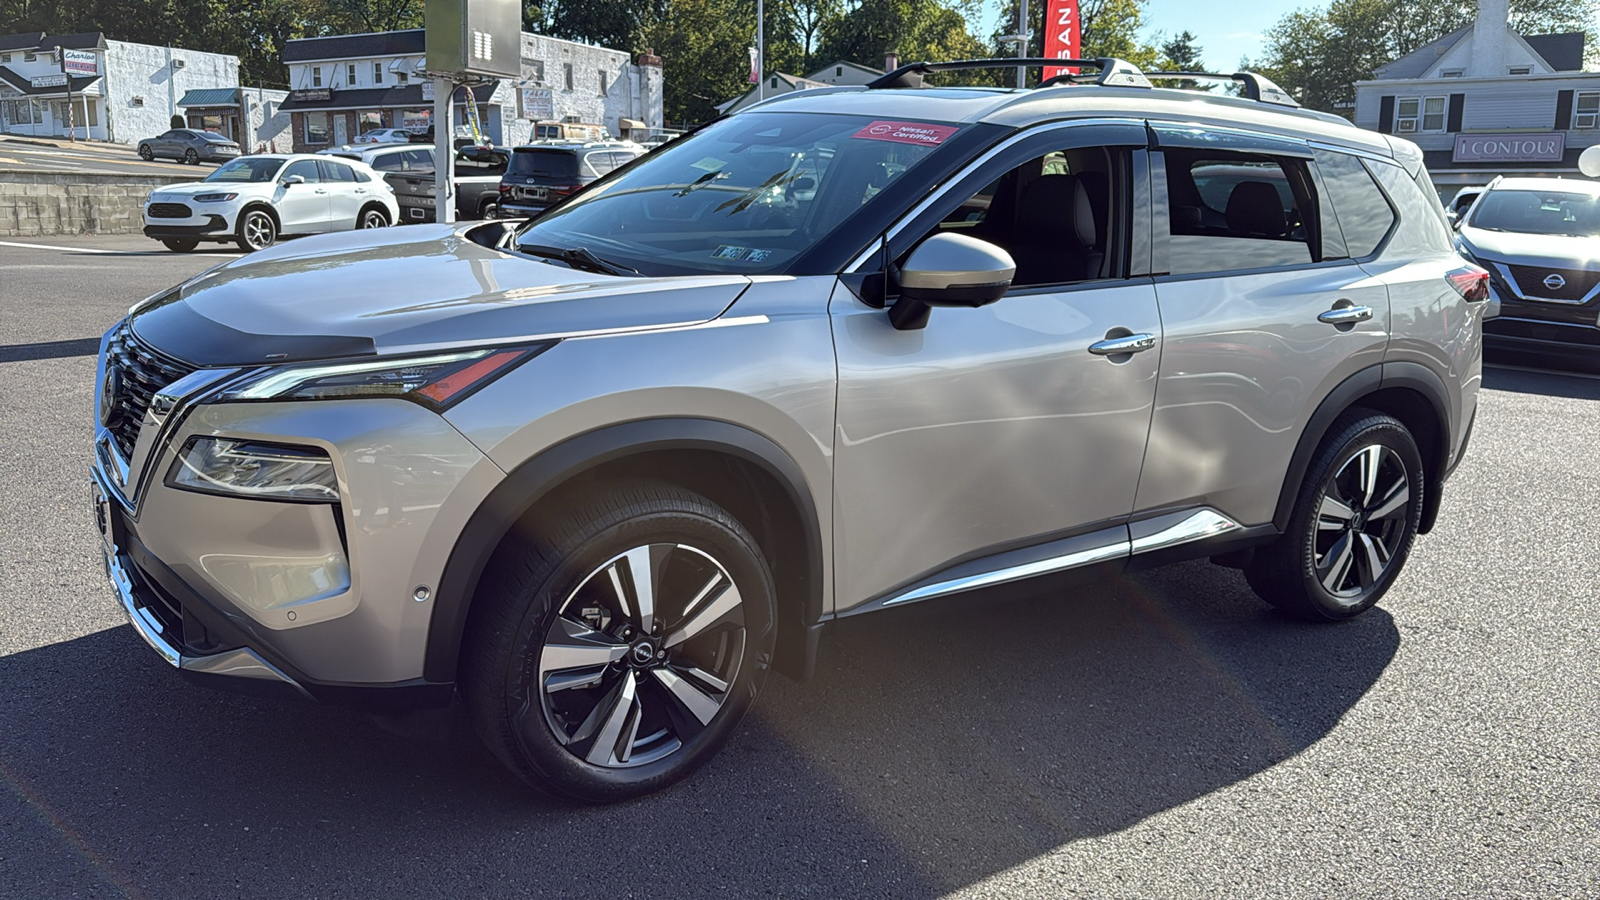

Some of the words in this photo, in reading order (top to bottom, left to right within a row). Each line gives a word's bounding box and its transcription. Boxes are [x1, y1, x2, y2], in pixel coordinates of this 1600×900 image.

[65, 52, 95, 60] Charles
[898, 126, 934, 135] Nissan
[892, 131, 939, 141] Certified
[1471, 140, 1556, 155] CONTOUR
